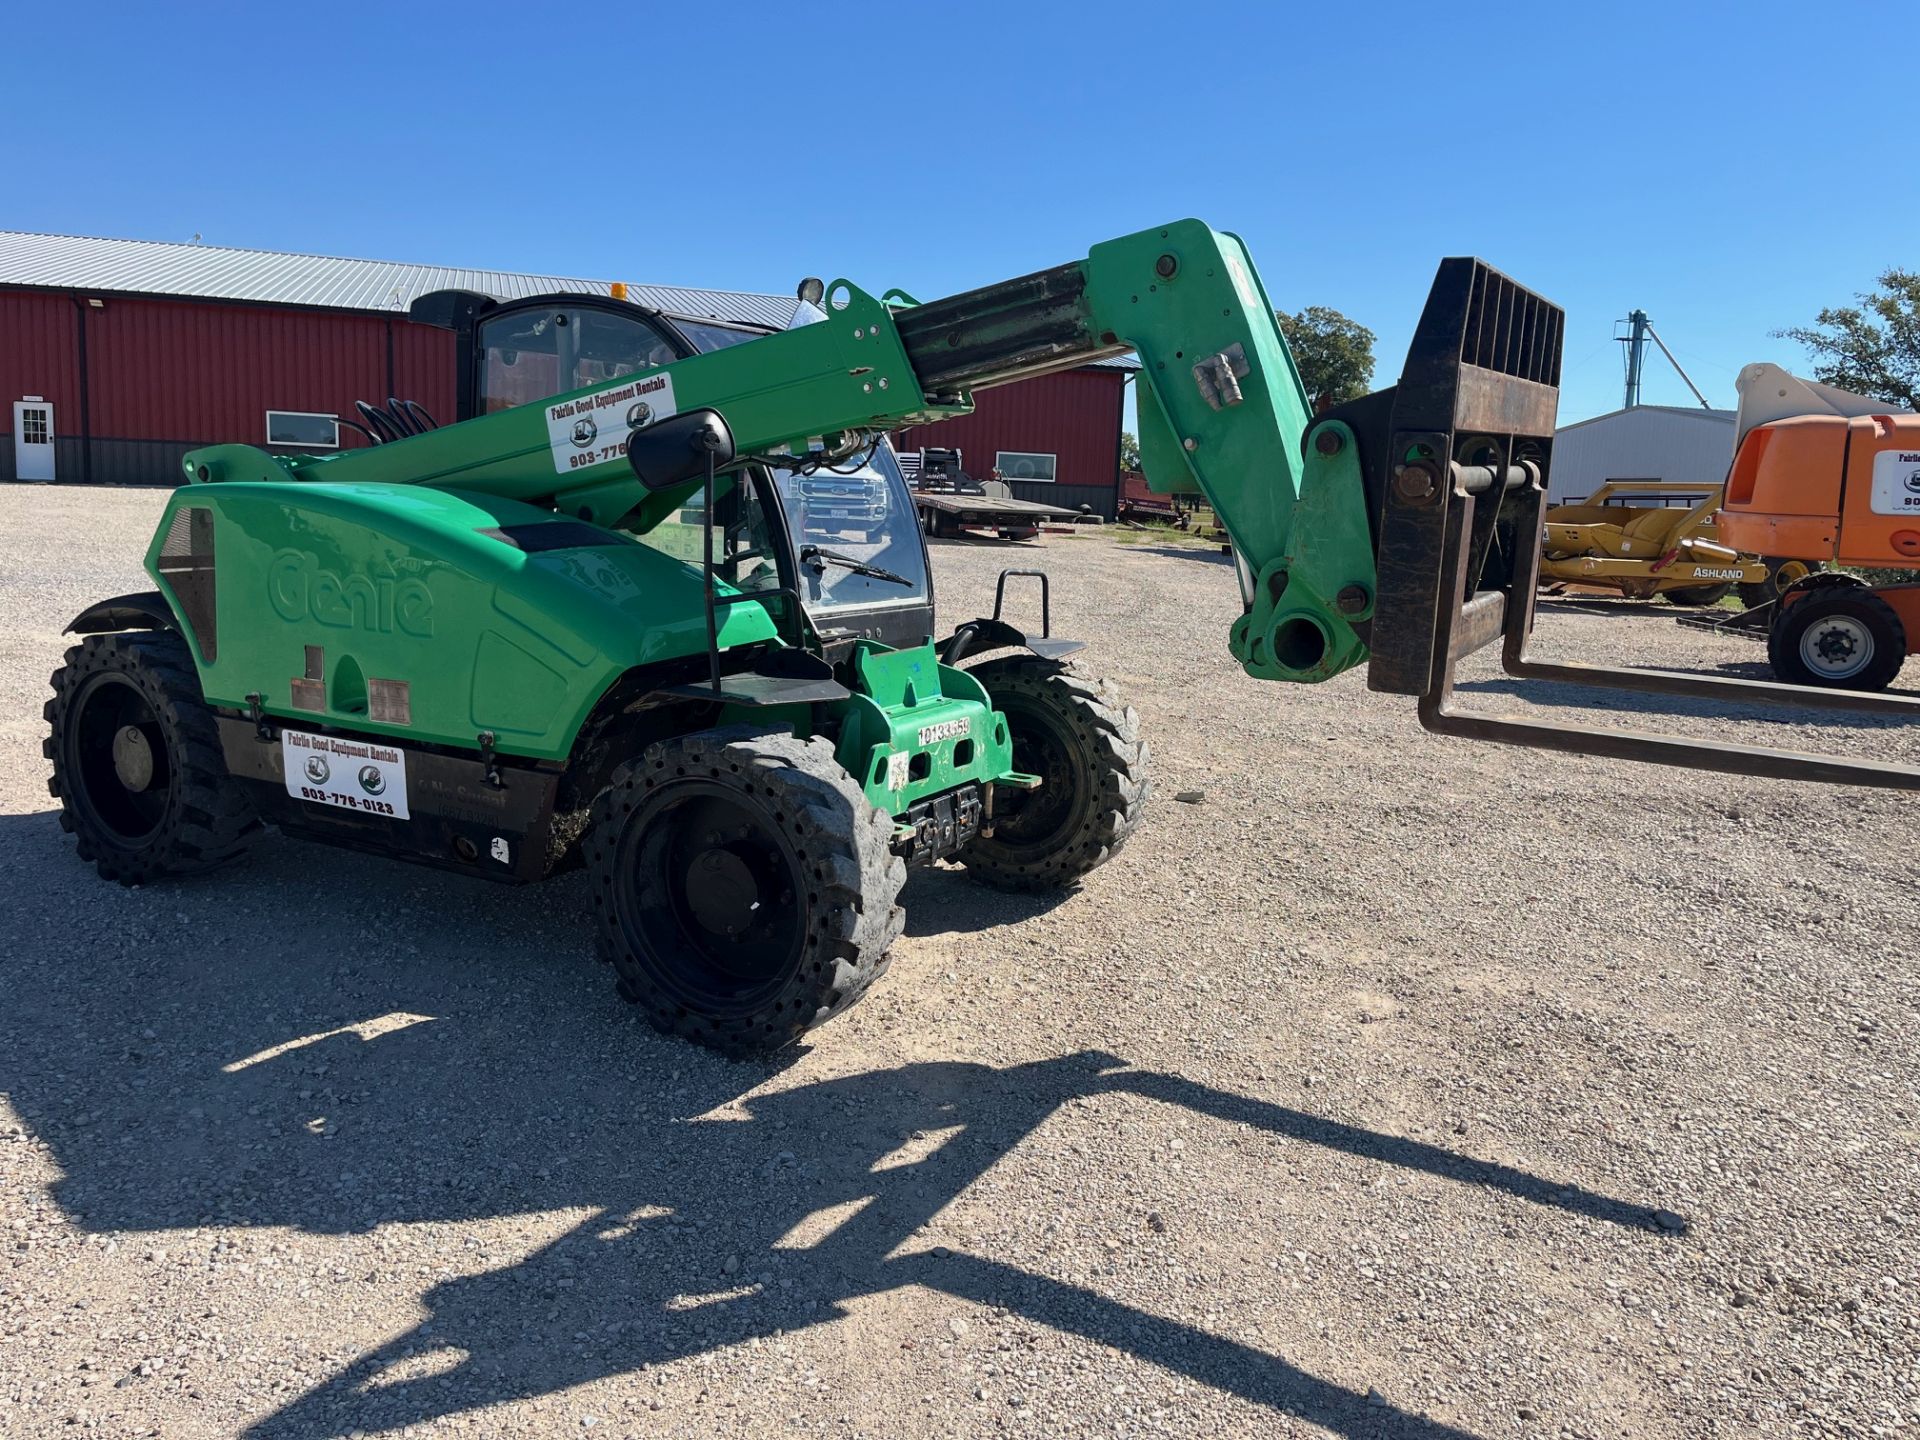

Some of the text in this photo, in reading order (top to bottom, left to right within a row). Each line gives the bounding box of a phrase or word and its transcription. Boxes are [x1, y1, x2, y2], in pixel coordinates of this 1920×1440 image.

[551, 377, 666, 420] Fairlie Good Equipment Rentals
[570, 443, 627, 468] 903-776
[1693, 567, 1743, 579] ASHLAND
[268, 547, 434, 638] Genie
[288, 732, 398, 763] Fairlie Good Equipment Rentals
[301, 787, 394, 815] 903-776-0123
